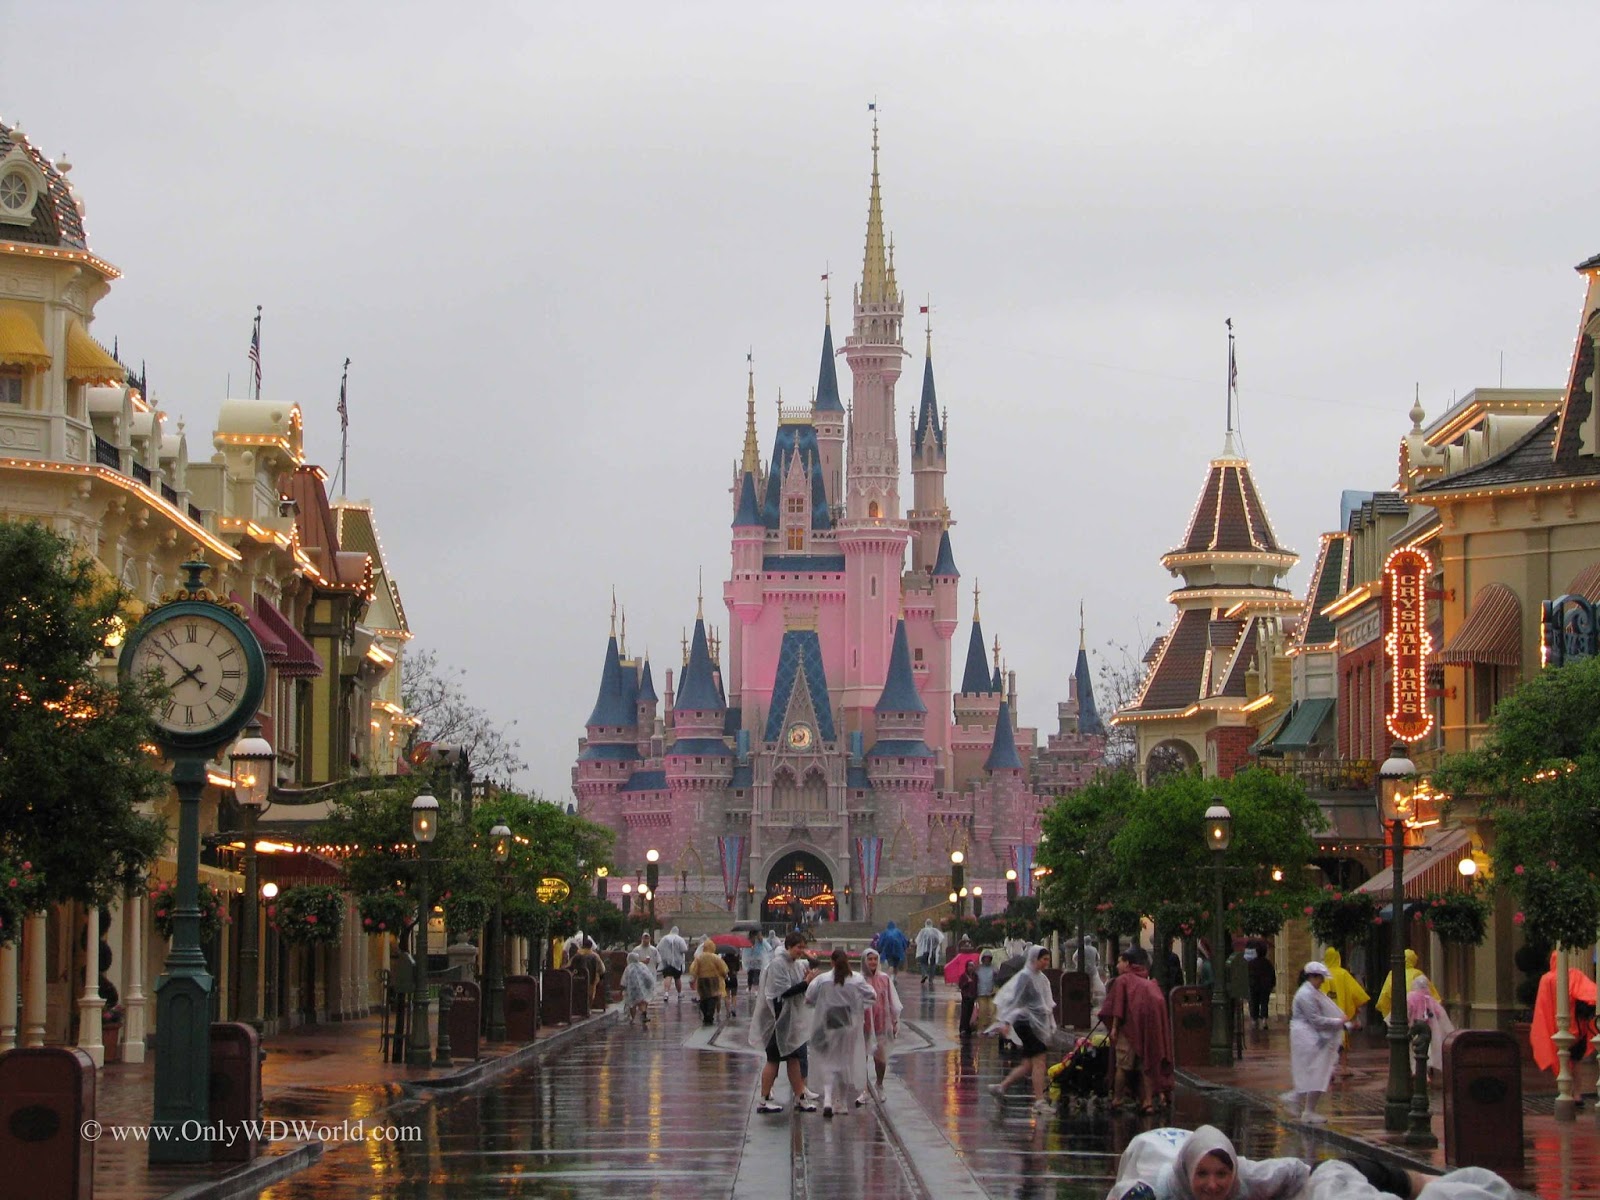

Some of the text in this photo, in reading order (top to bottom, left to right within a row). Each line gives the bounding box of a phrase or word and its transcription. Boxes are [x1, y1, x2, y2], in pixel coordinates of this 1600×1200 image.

[185, 624, 198, 644] XII
[1400, 574, 1418, 714] CRYSTAL ARTS
